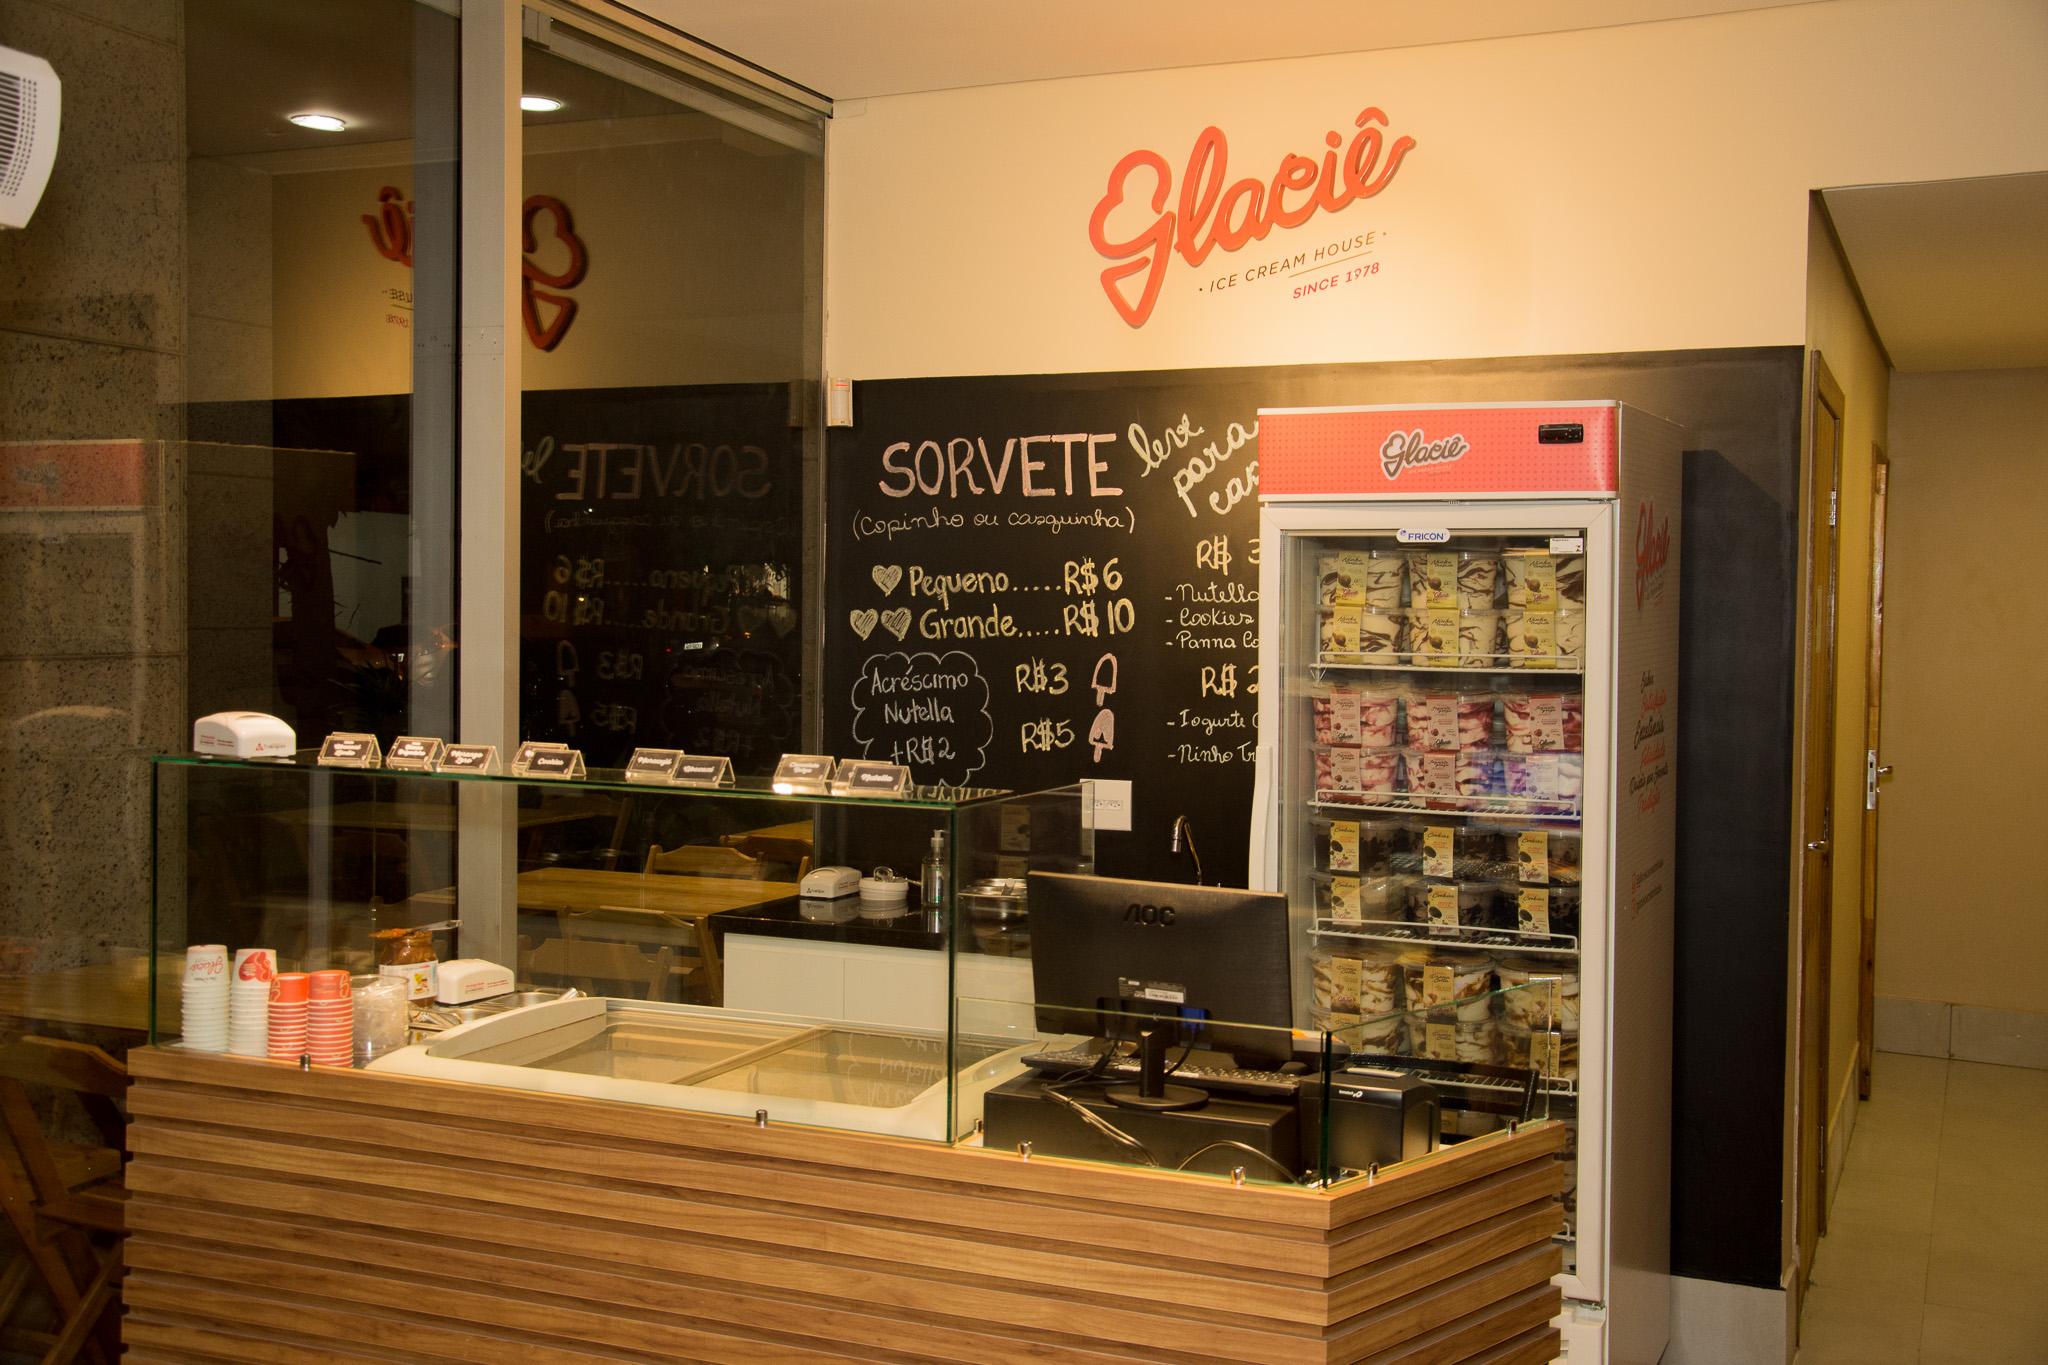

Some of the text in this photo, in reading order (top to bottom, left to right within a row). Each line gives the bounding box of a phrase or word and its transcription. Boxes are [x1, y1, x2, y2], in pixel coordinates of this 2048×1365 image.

[1088, 105, 1416, 329] Glaciê
[1209, 231, 1377, 293] ICE CREAM HOUSE
[1292, 262, 1381, 299] SINCE 1978
[878, 432, 1124, 499] SORVETE
[973, 512, 999, 526] ou
[1408, 532, 1444, 541] FRICON
[1179, 607, 1255, 627] Cookies
[1175, 630, 1237, 650] Panna
[871, 664, 969, 697] Acréscimo
[885, 702, 955, 725] Nutella
[1179, 709, 1246, 736] Iogurte
[1177, 743, 1234, 764] Ninho
[860, 772, 894, 783] Nutella
[1123, 903, 1176, 927] AOC
